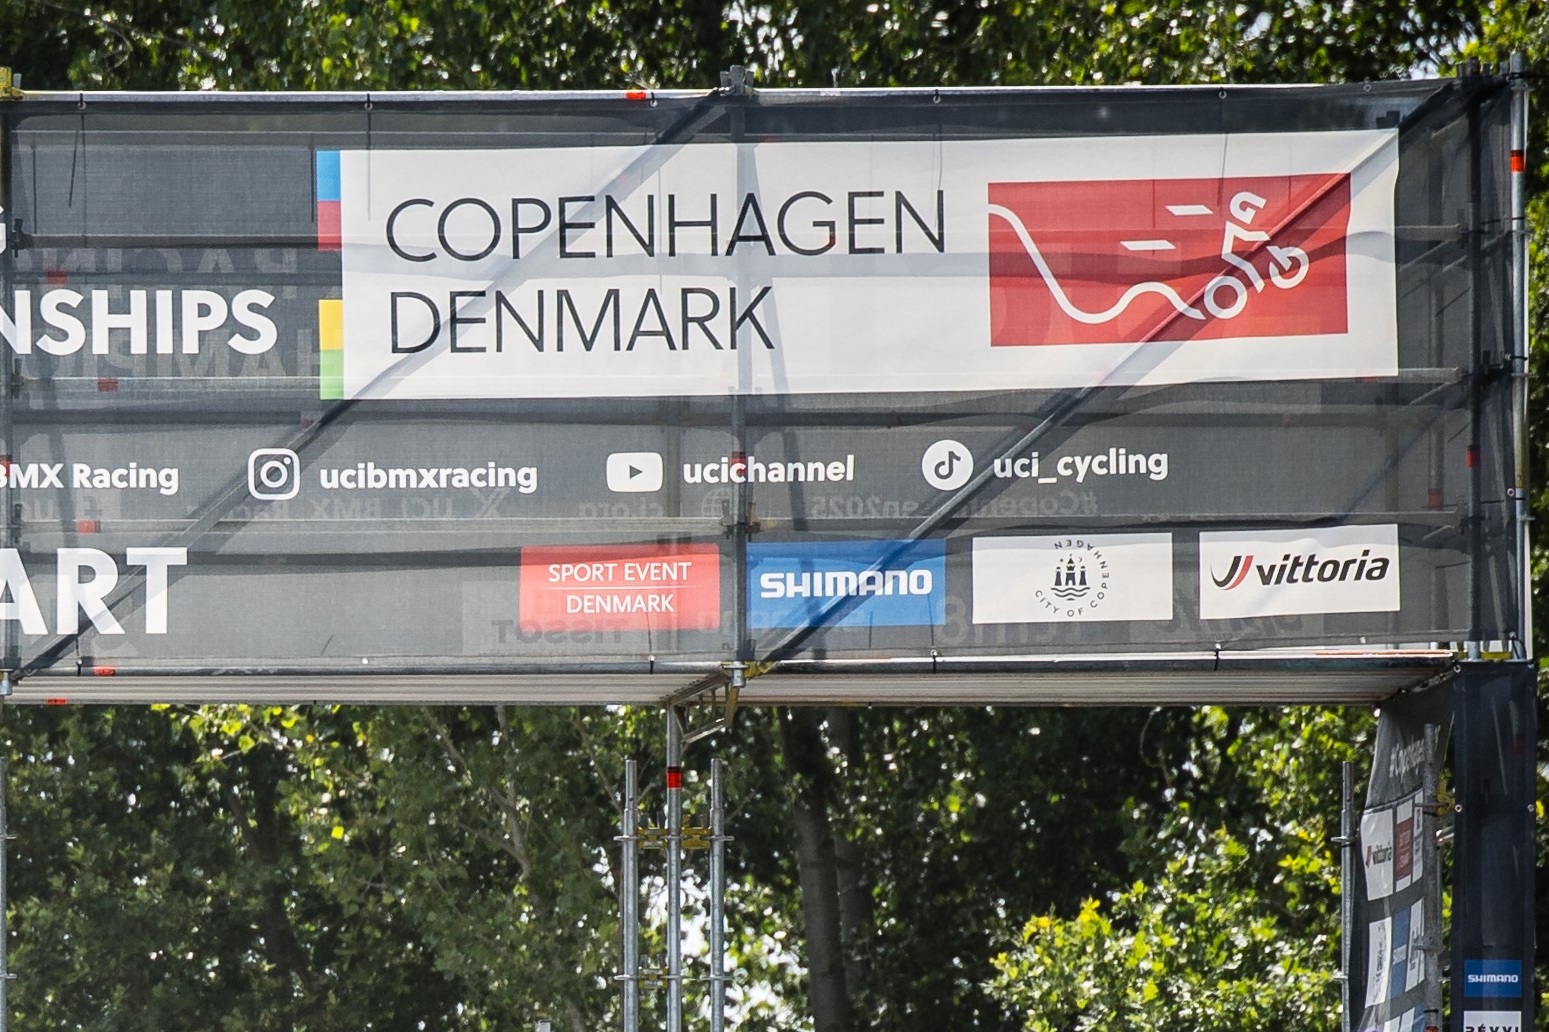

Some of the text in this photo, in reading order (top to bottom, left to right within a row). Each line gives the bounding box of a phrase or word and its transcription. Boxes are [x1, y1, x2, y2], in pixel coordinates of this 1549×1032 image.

[386, 190, 944, 263] COPENHAGEN
[391, 286, 775, 354] DENMARK
[73, 462, 179, 496] Racing
[320, 462, 538, 496] ucibmxracing
[683, 455, 855, 484] ucichannel
[993, 448, 1169, 483] uci_cycling
[548, 561, 692, 583] SPORT EVENT
[1255, 549, 1390, 586] vittoria
[760, 569, 933, 599] SHIMANO
[566, 594, 674, 614] DENMARK
[1035, 590, 1060, 614] CITY
[1067, 607, 1085, 617] OF
[1467, 974, 1519, 983] SHIMANO
